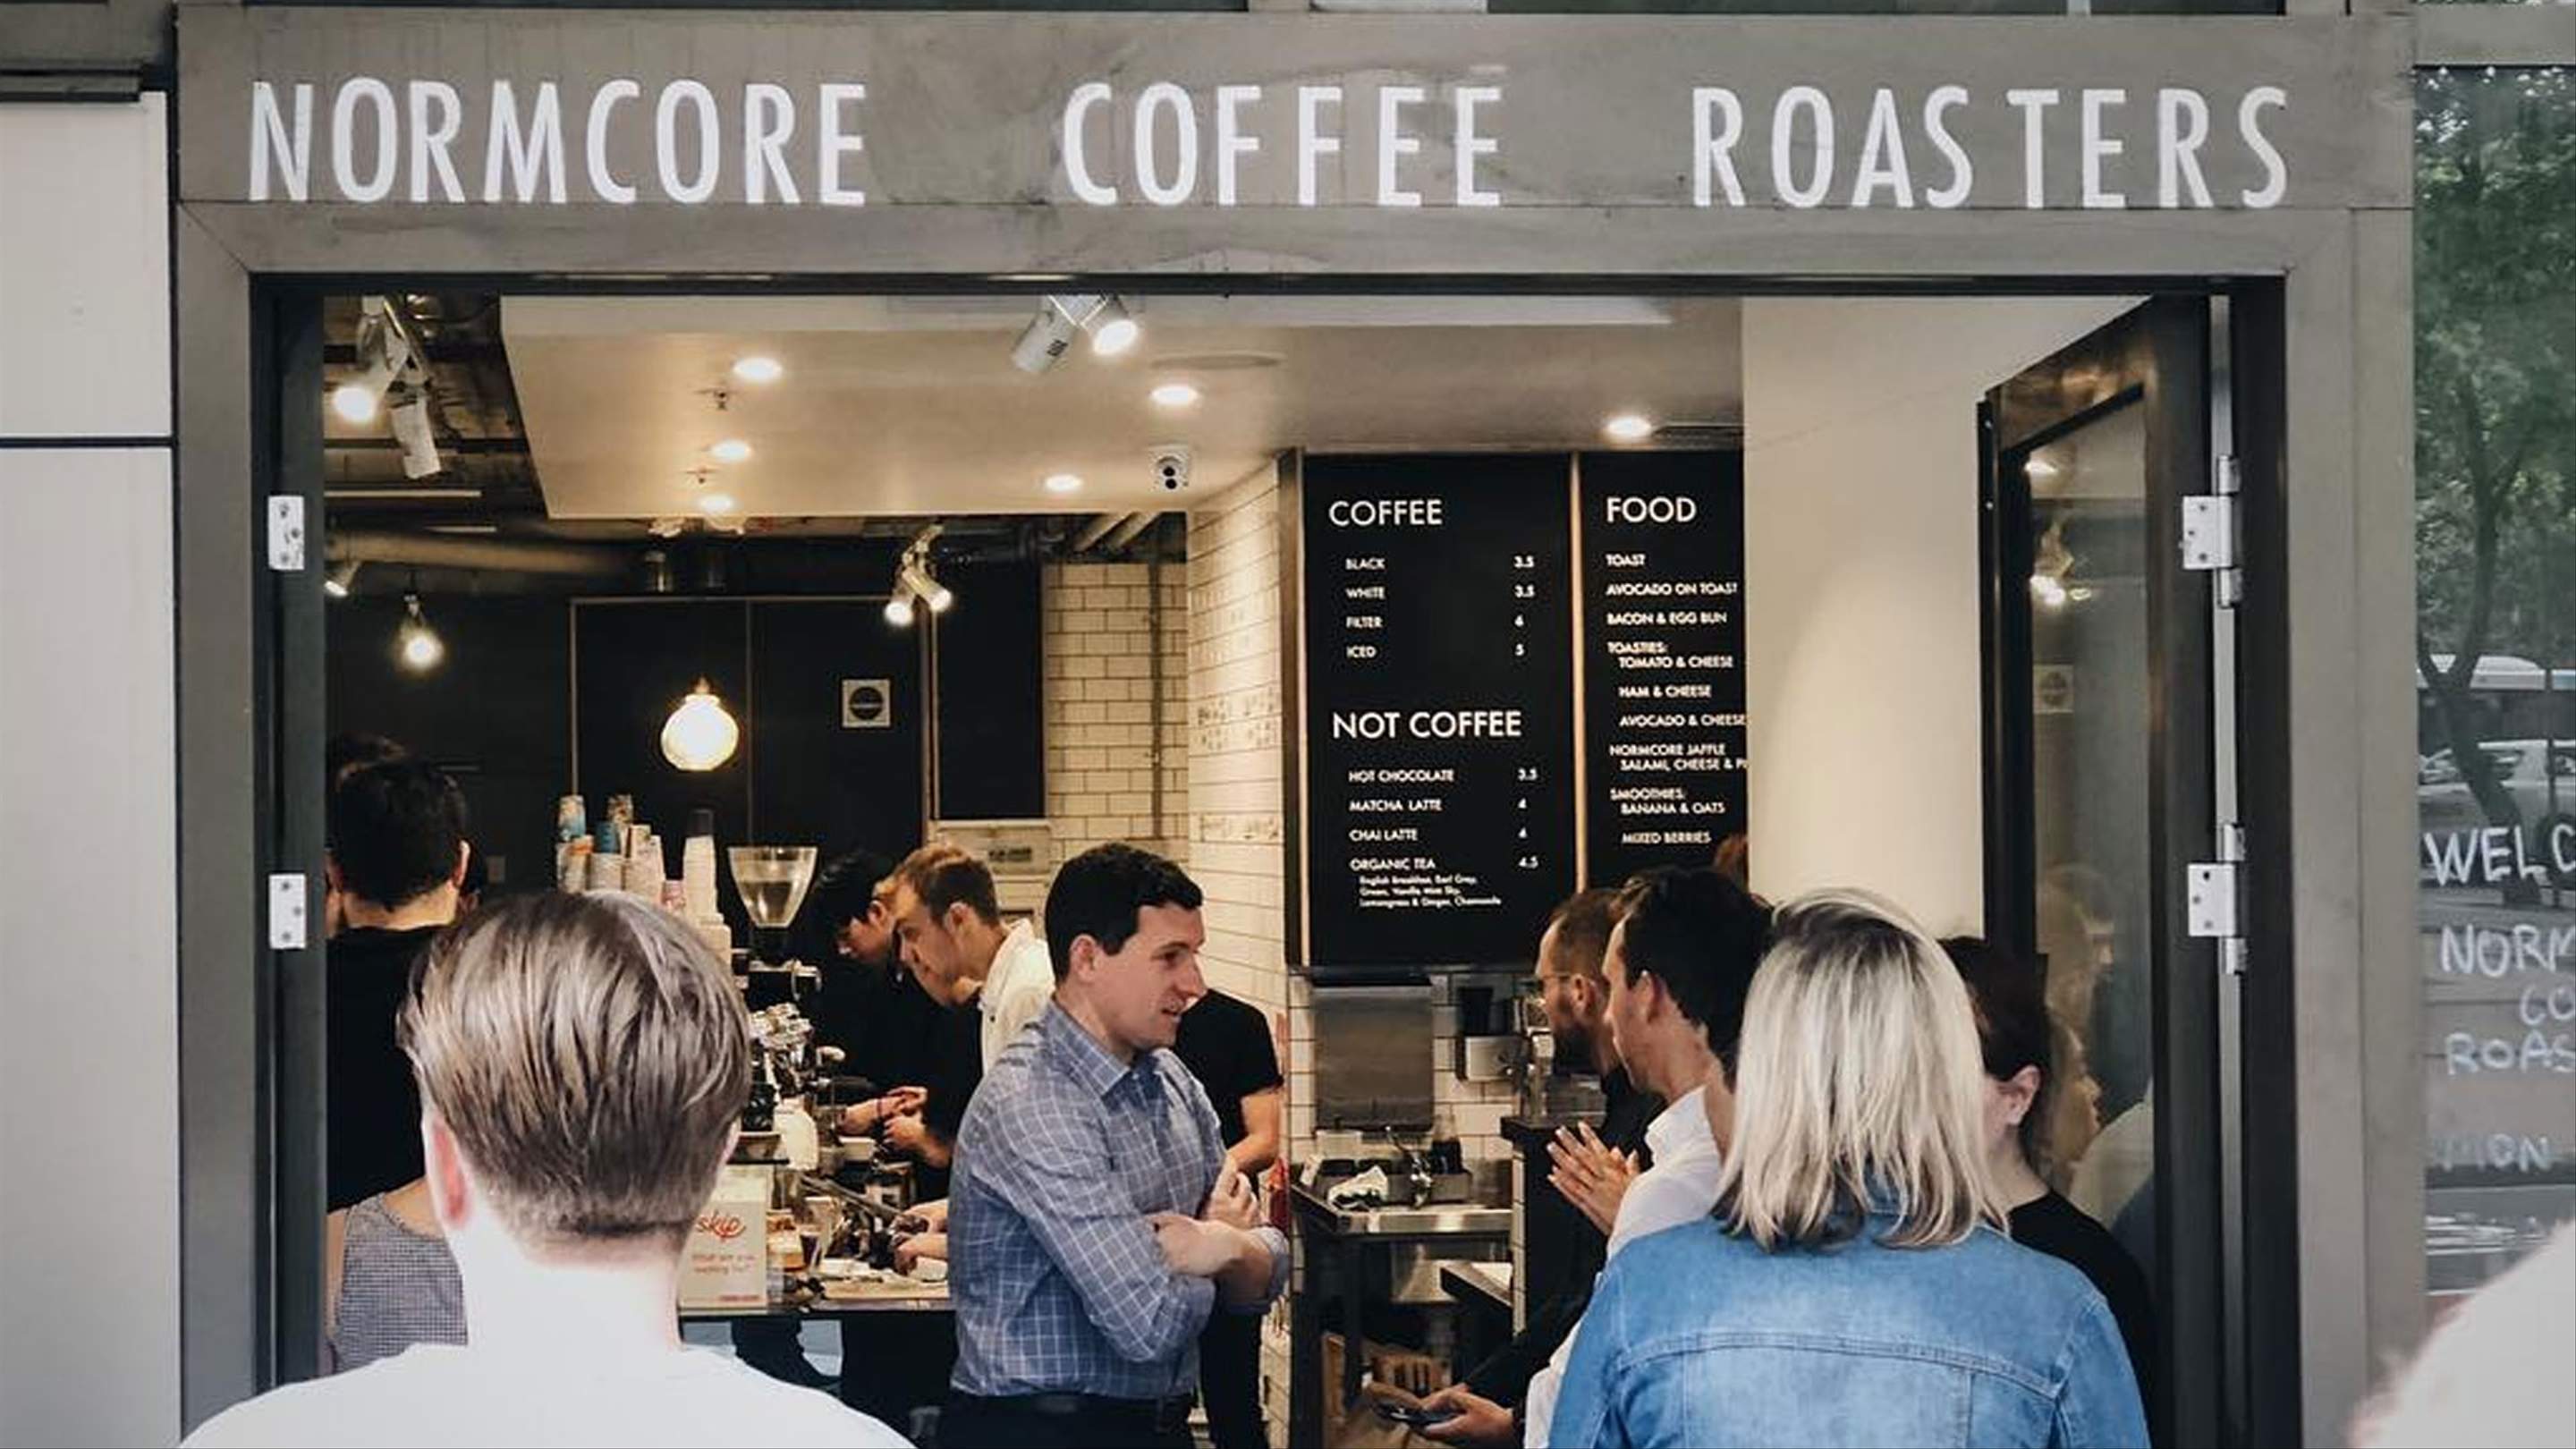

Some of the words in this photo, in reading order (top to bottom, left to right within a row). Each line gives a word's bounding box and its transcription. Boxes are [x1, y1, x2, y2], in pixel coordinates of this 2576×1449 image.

[250, 78, 867, 206] NORMCORE
[1063, 82, 1503, 206] COFFEE
[1692, 86, 2288, 208] ROASTERS
[1328, 499, 1444, 527] COFFEE
[1606, 496, 1697, 523] FOOD
[1345, 557, 1385, 571] BLACK
[1513, 555, 1535, 569] 3.5
[1606, 553, 1647, 567] TOAST
[1345, 586, 1385, 600] WHITE
[1513, 583, 1536, 598] 3.5
[1606, 582, 1673, 597] AVOCADO
[1674, 582, 1697, 597] ON
[1699, 581, 1738, 596] TOAST
[1345, 615, 1384, 629] FILTER
[1606, 612, 1655, 626] BACON
[1656, 611, 1666, 625] &
[1668, 610, 1698, 625] EGG
[1700, 610, 1729, 624] BUN
[1346, 644, 1377, 658] ICED
[1514, 642, 1525, 657] 5
[1618, 655, 1674, 669] TOMATO
[1675, 655, 1687, 668] &
[1688, 655, 1734, 669] CHEESE
[1618, 685, 1650, 699] HAM
[1652, 684, 1664, 698] &
[1665, 684, 1712, 699] CHEESE
[1332, 712, 1400, 739] NOT
[1409, 709, 1522, 739] COFFEE
[1619, 714, 1686, 727] AVOCADO
[1687, 713, 1699, 726] &
[1610, 744, 1684, 757] NORMCORE
[1687, 743, 1726, 756] JAFFLE
[1673, 758, 1720, 771] CHEESE
[1723, 758, 1734, 769] &
[1348, 770, 1376, 783] HOT
[1377, 768, 1454, 783] CHOCOLATE
[1518, 767, 1538, 781] 3.5
[1349, 799, 1404, 812] MATCHA
[1408, 798, 1443, 811] LATTE
[1517, 798, 1527, 809] 4
[1621, 802, 1677, 815] BANANA
[1679, 802, 1690, 814] &
[1691, 801, 1726, 814] OATS
[1349, 828, 1381, 842] CHAI
[1384, 827, 1418, 841] LATTE
[1518, 827, 1528, 839] 4
[1622, 831, 1663, 844] MIXED
[1664, 829, 1712, 843] BERRIES
[2424, 823, 2576, 886] WELC
[1349, 857, 1411, 871] ORGANIC
[1413, 856, 1436, 869] TEA
[1517, 856, 1539, 869] 4.5
